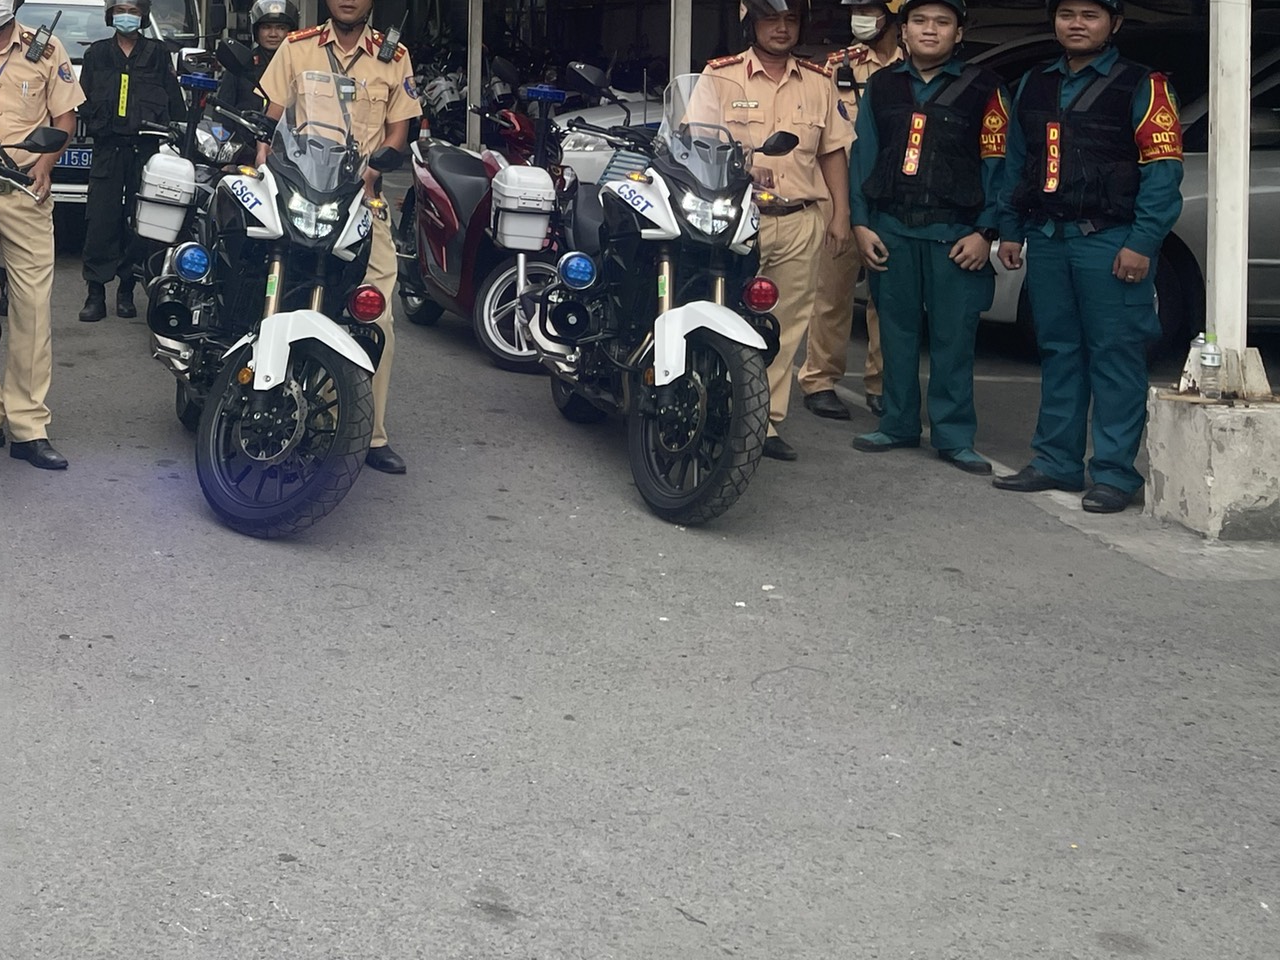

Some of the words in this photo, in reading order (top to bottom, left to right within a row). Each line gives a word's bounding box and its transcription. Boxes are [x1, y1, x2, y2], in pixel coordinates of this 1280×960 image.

[56, 151, 92, 166] 15.9
[231, 180, 262, 210] CSGT
[618, 184, 654, 213] CSGT
